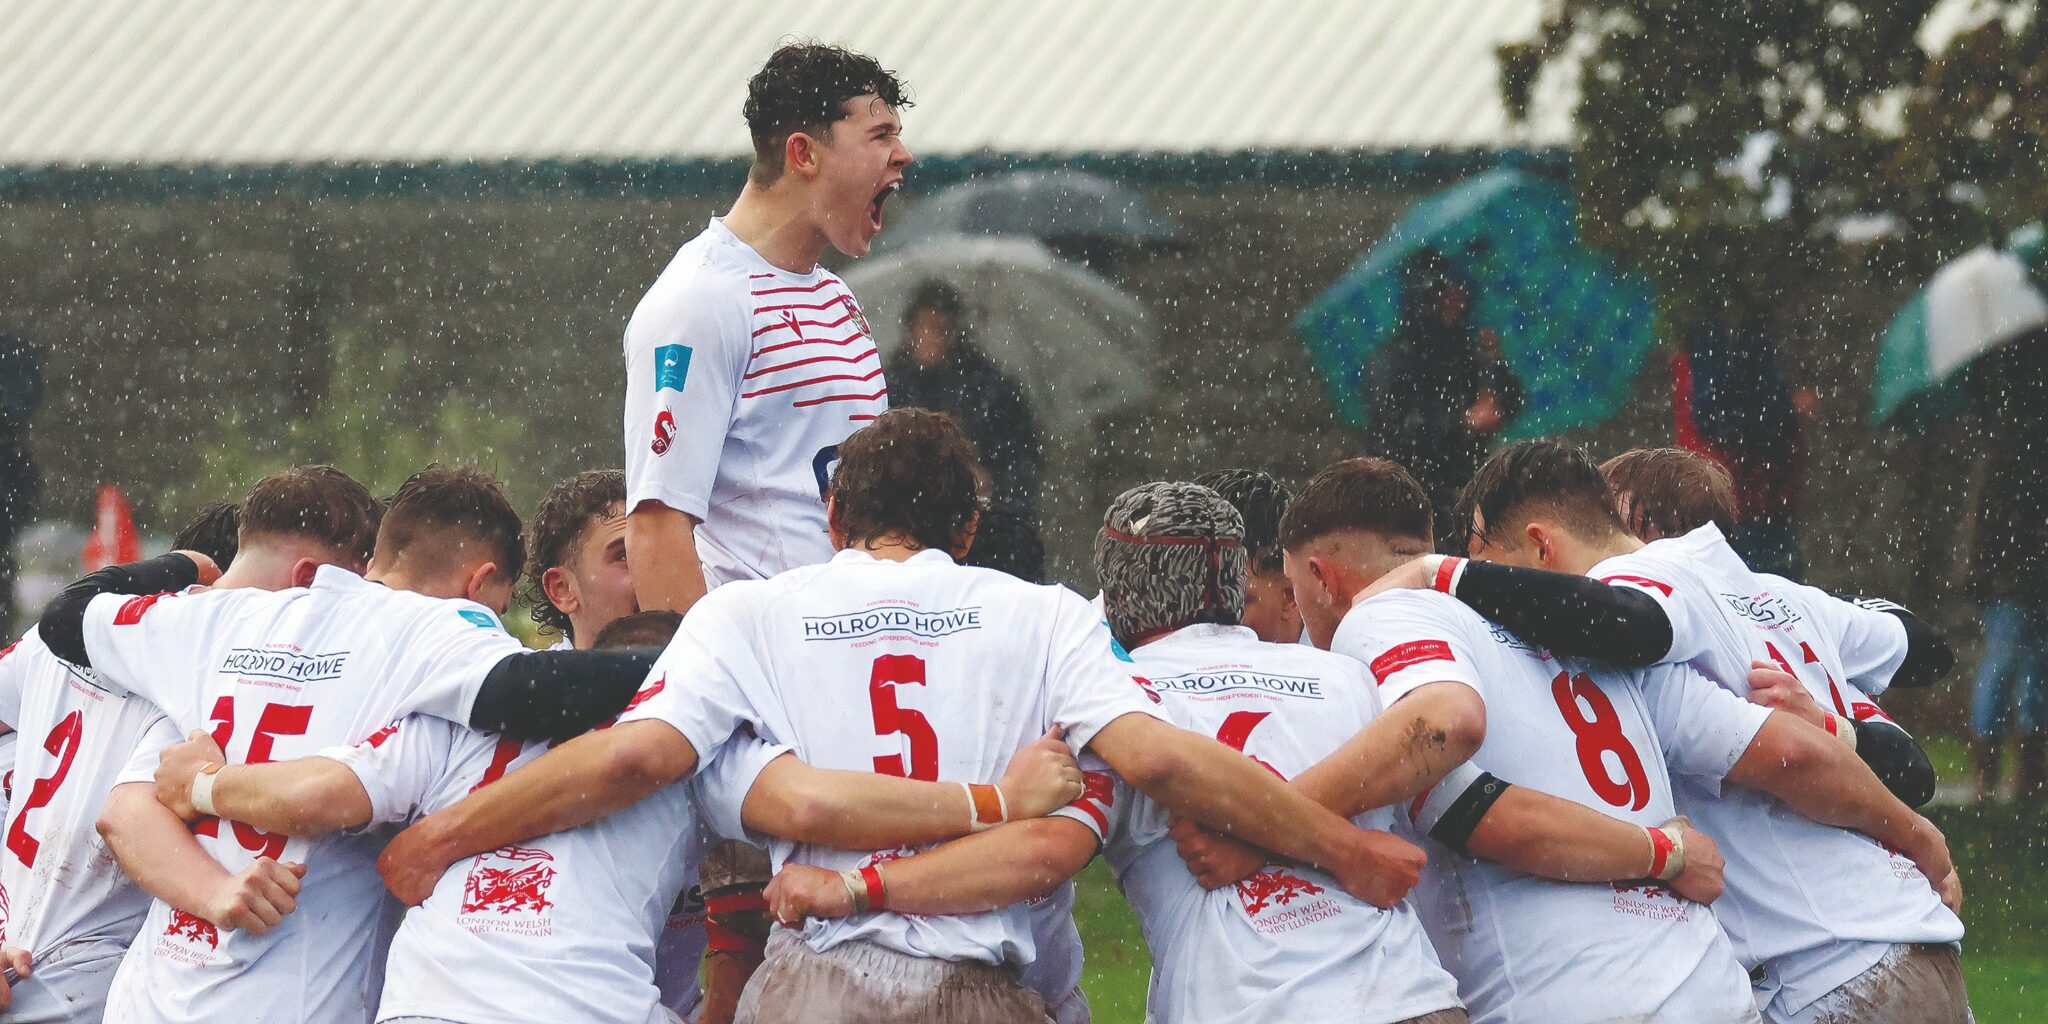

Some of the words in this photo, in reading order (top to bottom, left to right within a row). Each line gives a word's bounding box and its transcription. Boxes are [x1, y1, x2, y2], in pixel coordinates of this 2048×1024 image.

[804, 612, 910, 636] HOLROYD
[915, 611, 980, 633] HOWE
[850, 638, 878, 649] FEEDING
[288, 657, 347, 677] HOWE
[1154, 674, 1247, 691] OLROYD
[1252, 675, 1322, 696] HOWE
[868, 653, 939, 783] 5
[1551, 670, 1651, 812] 8
[6, 709, 83, 869] 2
[1613, 895, 1658, 911] LONDON
[456, 917, 510, 927] LONDON
[514, 917, 551, 929] WELSH
[1253, 909, 1297, 928] ONDON
